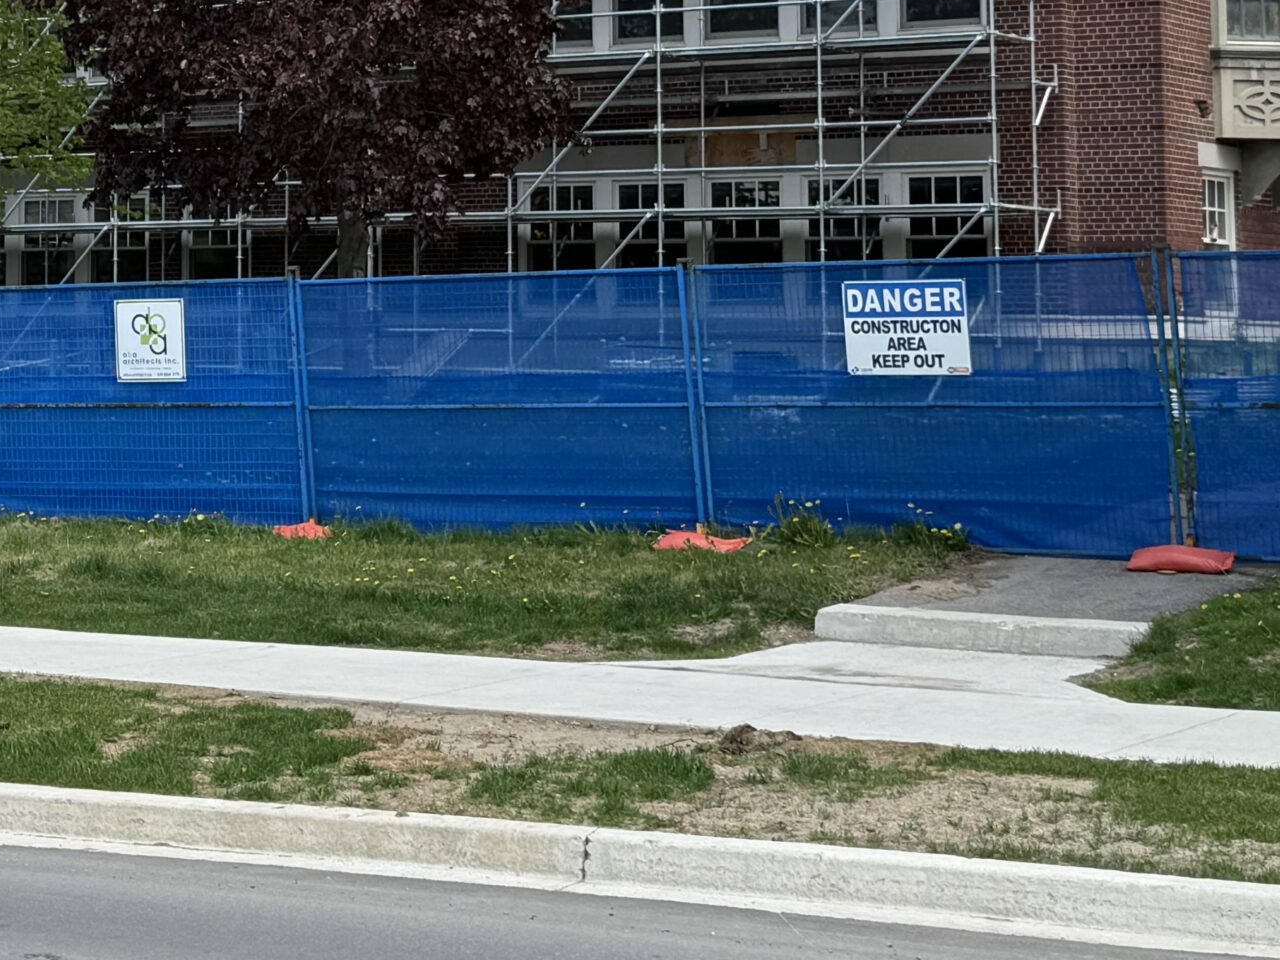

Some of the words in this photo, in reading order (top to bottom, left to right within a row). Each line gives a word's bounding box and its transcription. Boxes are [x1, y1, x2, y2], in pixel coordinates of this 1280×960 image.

[846, 287, 963, 313] DANGER
[850, 319, 962, 335] CONSTRUCTON
[887, 336, 928, 351] AREA
[122, 357, 162, 365] architects
[871, 354, 910, 368] KEEP
[913, 353, 945, 368] OUT
